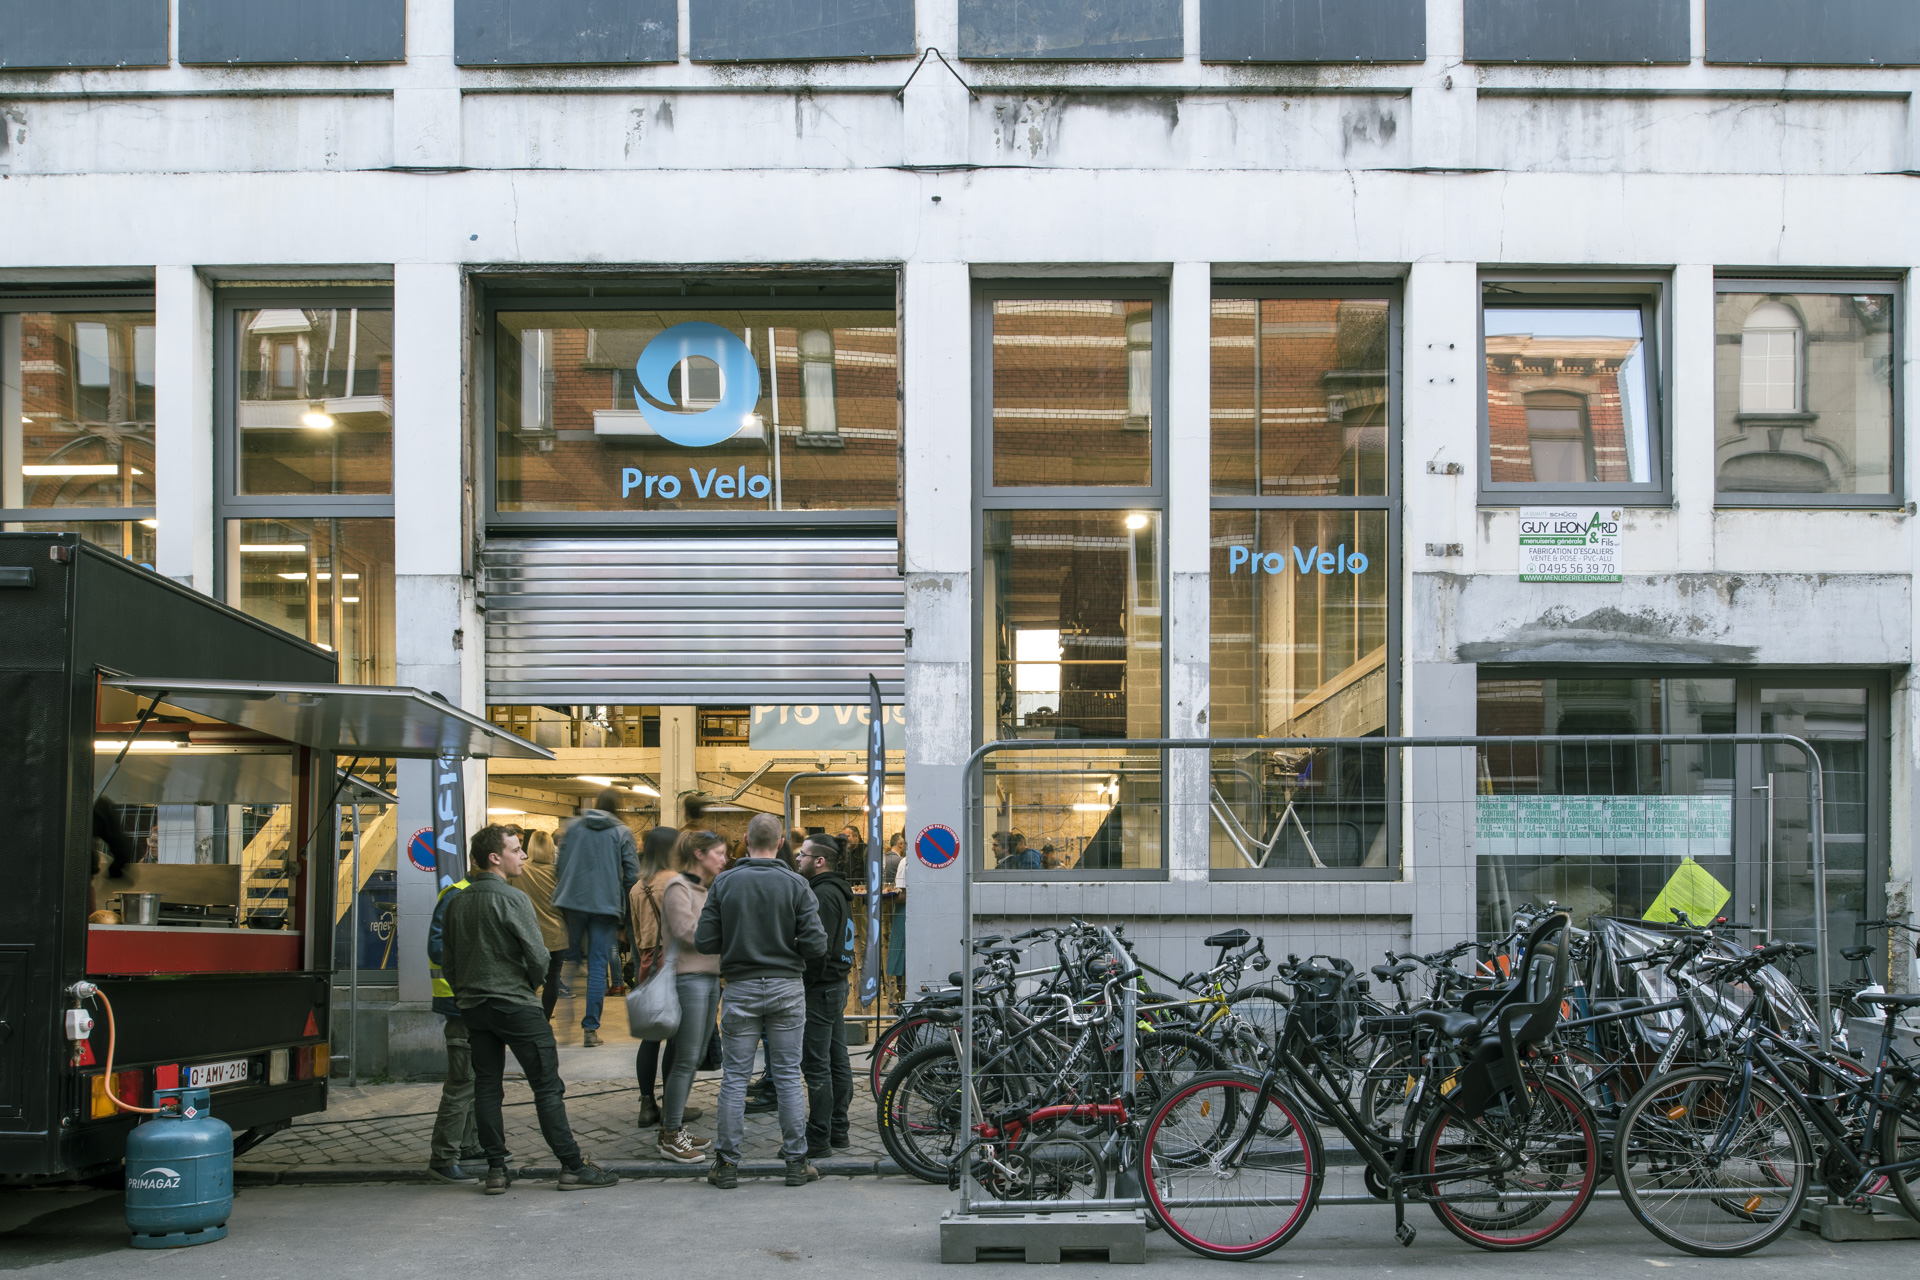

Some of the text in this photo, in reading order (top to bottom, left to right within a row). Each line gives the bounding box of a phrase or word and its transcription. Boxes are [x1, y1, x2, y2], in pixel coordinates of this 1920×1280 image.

[622, 465, 771, 498] Pro Velo
[1522, 512, 1618, 536] GUY LEONARD
[1589, 532, 1614, 546] & Fils
[1230, 543, 1369, 574] Pro Velo
[1539, 564, 1614, 573] 0495 56 39 70
[1659, 1028, 1685, 1073] OXFORD
[128, 1178, 181, 1189] PRIMAGAZ
